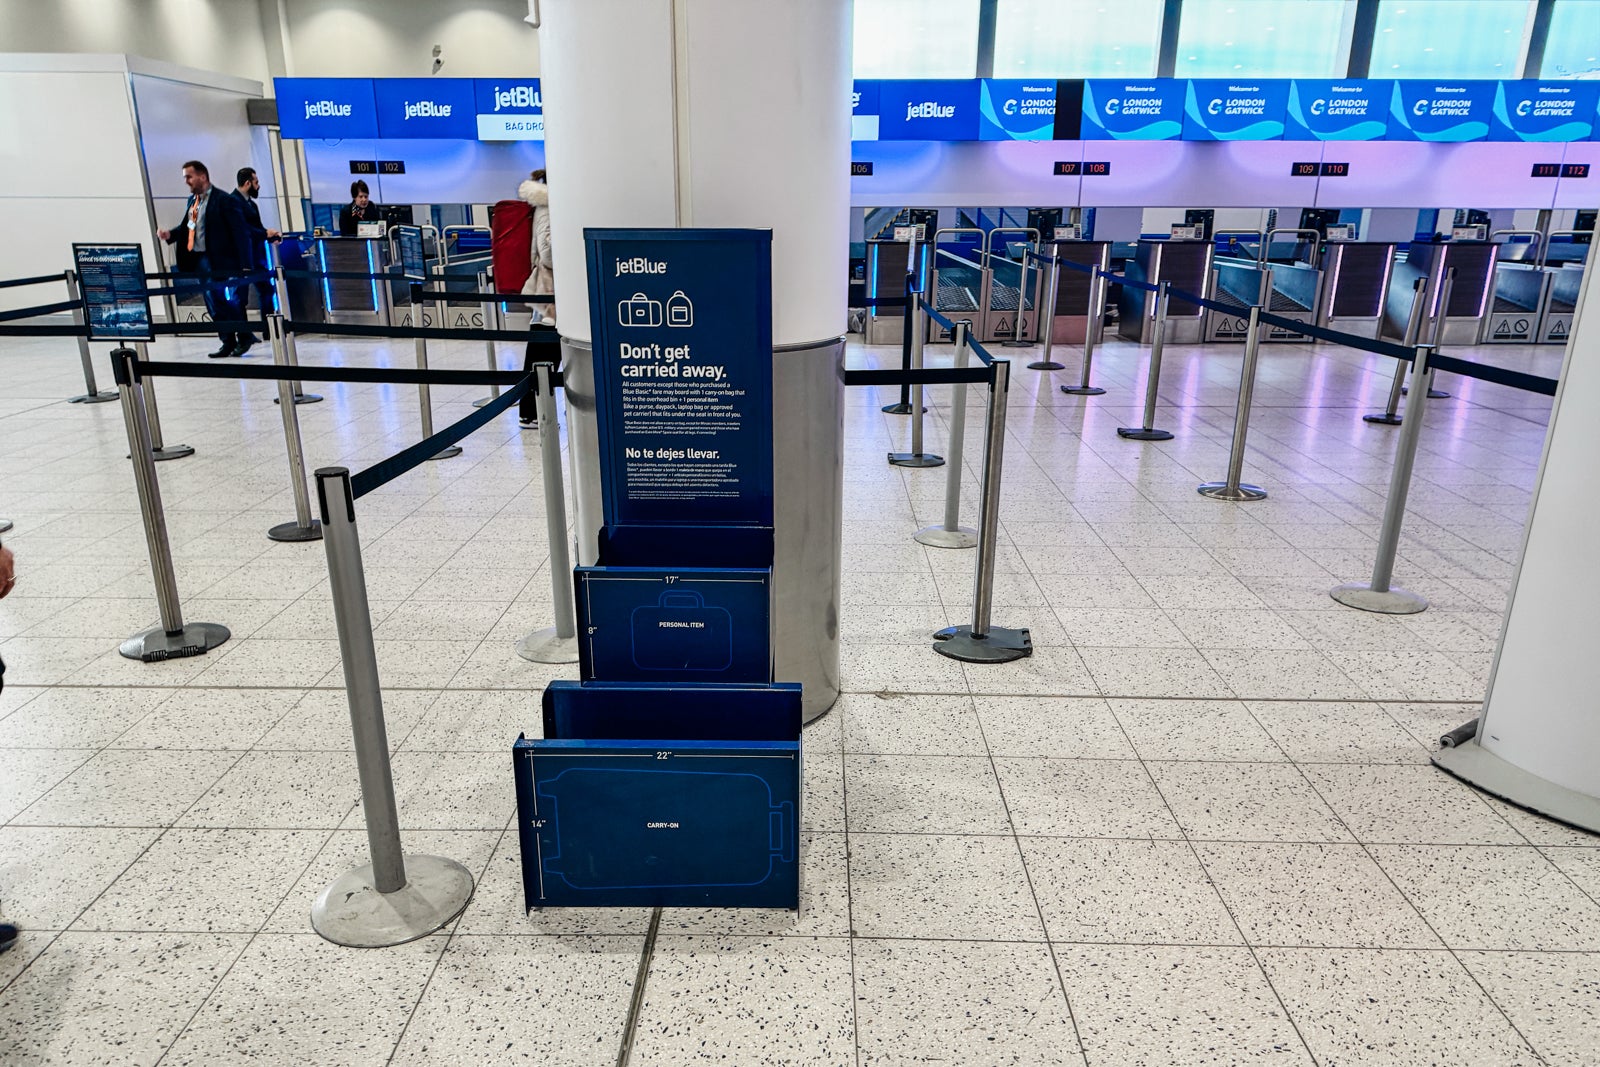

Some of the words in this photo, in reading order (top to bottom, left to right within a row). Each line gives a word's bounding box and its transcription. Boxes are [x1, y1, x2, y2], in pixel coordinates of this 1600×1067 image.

[305, 101, 351, 119] jetBlue
[404, 101, 451, 120] jetBlue
[906, 102, 954, 121] jetBlue
[506, 122, 523, 130] BAG
[357, 163, 369, 172] 101
[384, 163, 399, 172] 102
[1061, 164, 1075, 172] 107
[1090, 164, 1104, 172] 108
[1298, 165, 1314, 174] 109
[1327, 165, 1343, 174] 110
[1539, 166, 1554, 174] 111
[1569, 166, 1584, 175] 112
[615, 258, 667, 277] jetBlue
[620, 343, 660, 359] Don't
[665, 345, 690, 363] get
[621, 362, 678, 378] carried
[682, 366, 727, 381] away.
[625, 448, 640, 458] No
[643, 449, 654, 458] te
[656, 448, 684, 460] dejes
[687, 448, 719, 458] llevar.
[665, 576, 679, 584] 17"
[657, 752, 672, 760] 22"
